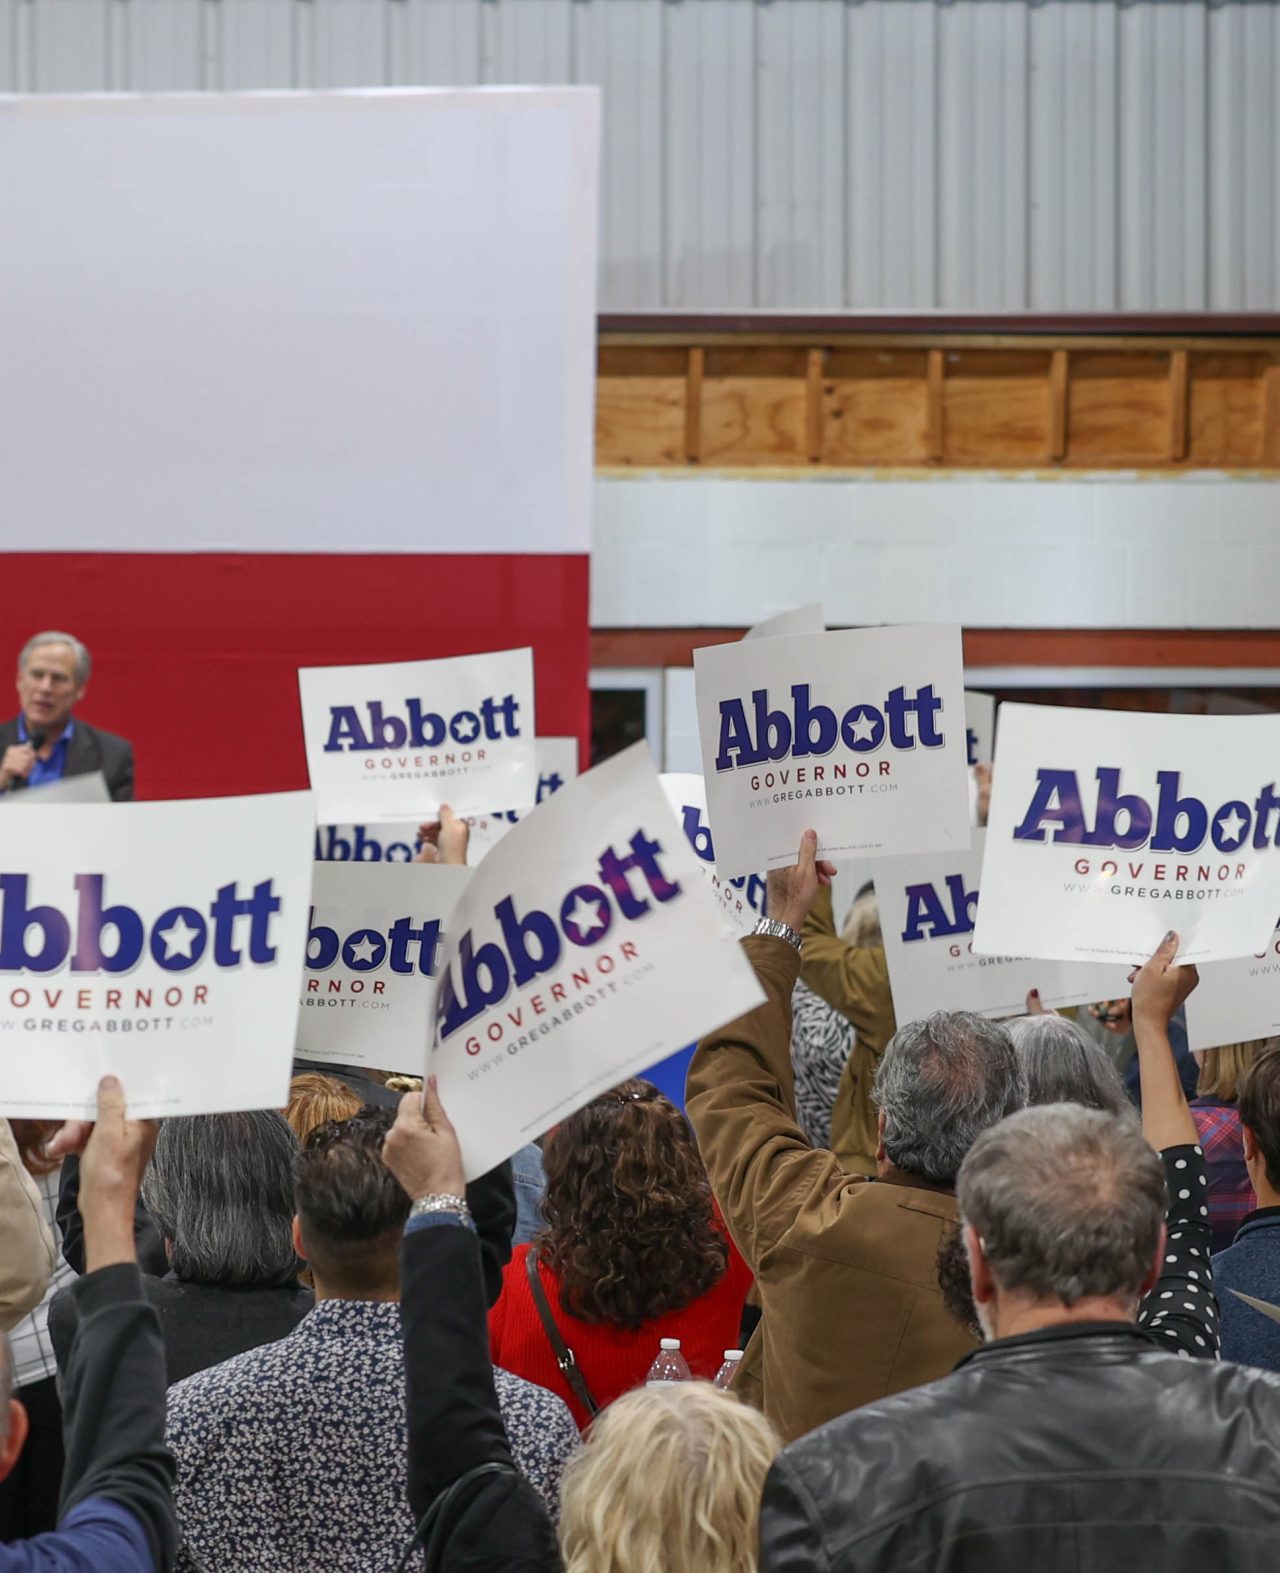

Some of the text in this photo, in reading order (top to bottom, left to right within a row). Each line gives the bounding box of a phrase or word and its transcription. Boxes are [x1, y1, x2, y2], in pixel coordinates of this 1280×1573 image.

[324, 694, 520, 752] Abbott
[715, 683, 945, 772] Abbott
[365, 749, 487, 769] GOVERNOR
[751, 761, 891, 791] GOVERNOR
[749, 783, 898, 808] WWW.GREGABBOTT.COM
[1075, 858, 1246, 881] GOVERNOR
[433, 827, 683, 1049] Abbott
[465, 940, 639, 1057] GOVERNOR
